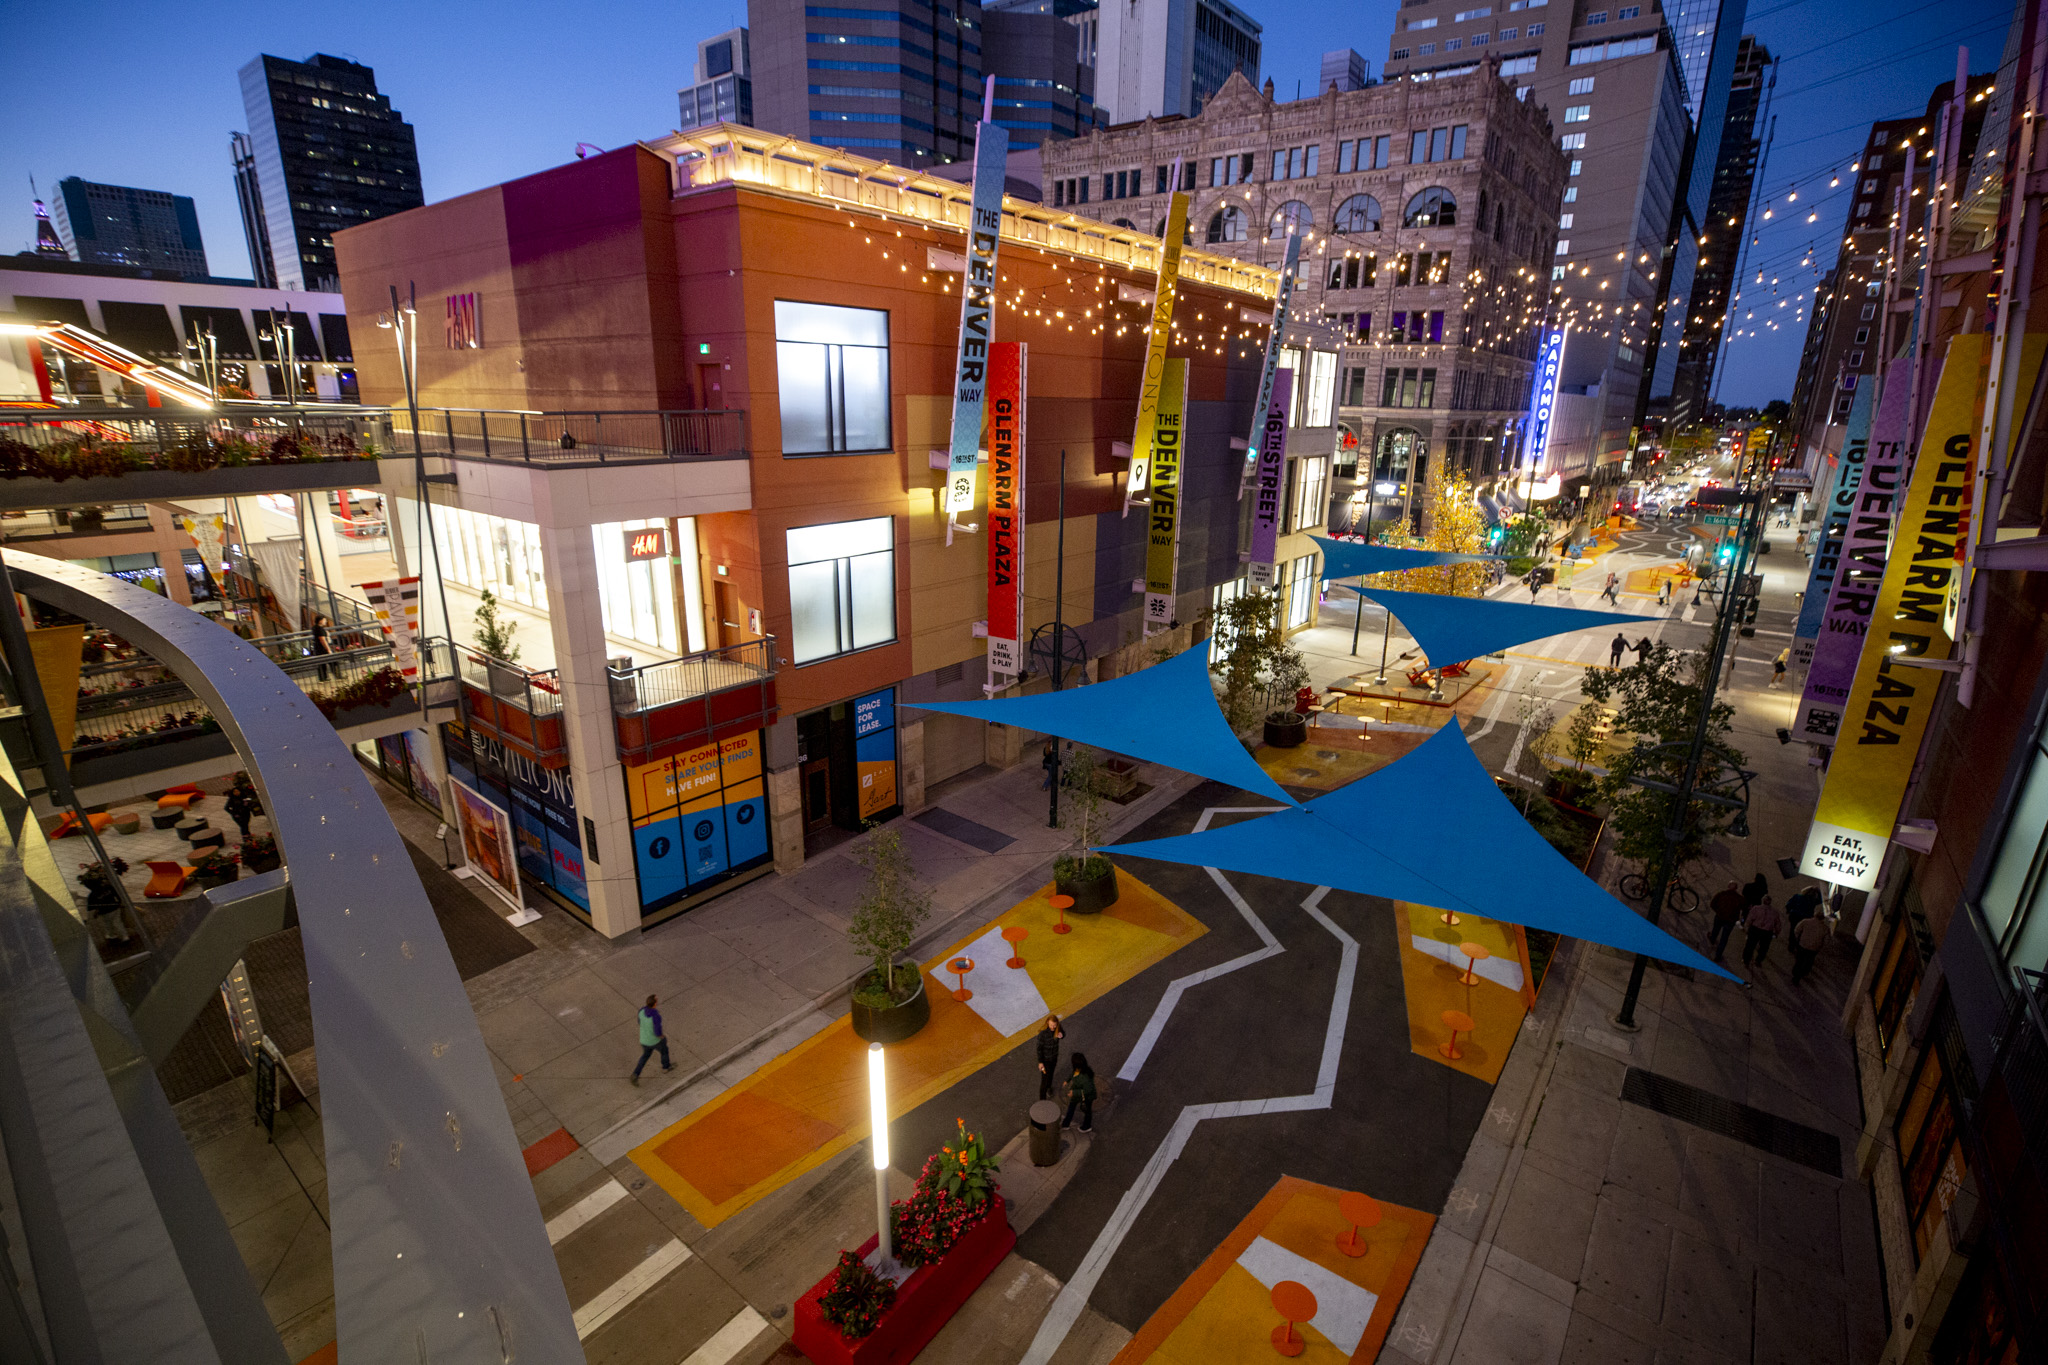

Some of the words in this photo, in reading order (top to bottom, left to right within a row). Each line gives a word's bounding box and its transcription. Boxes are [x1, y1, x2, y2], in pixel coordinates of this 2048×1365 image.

[976, 207, 998, 229] THE
[961, 231, 996, 383] DENVER
[443, 292, 479, 349] H&M
[960, 389, 982, 402] WAY
[1260, 360, 1276, 413] PLAZA
[1532, 334, 1562, 457] PARAMO
[1157, 413, 1179, 426] THE
[995, 399, 1012, 511] GLENARM
[1152, 429, 1178, 533] DENVER
[1713, 516, 1726, 525] 16th
[1727, 518, 1748, 527] Stret
[1896, 434, 1972, 623] GLENARM
[631, 533, 659, 556] H&M
[995, 516, 1011, 586] PLAZA
[1151, 534, 1172, 547] WAY
[993, 650, 1012, 660] DRINK,
[996, 643, 1008, 651] EAT,
[1794, 649, 1813, 657] DENV
[998, 660, 1012, 668] PLAY
[1799, 657, 1812, 665] WA
[1858, 631, 1932, 745] PLAZA
[857, 699, 881, 713] SPACE
[858, 712, 873, 723] FOR
[858, 720, 881, 734] LEASE.
[470, 729, 482, 756] DENVE
[663, 758, 687, 772] STAY
[689, 738, 748, 763] CONNECTED
[665, 767, 697, 784] SHARE
[699, 757, 725, 773] YOUR
[727, 748, 754, 764] FINDS
[666, 780, 692, 797] HAVE
[694, 772, 717, 787] FUN!
[1834, 835, 1862, 852] EAT,
[1814, 857, 1824, 868] &
[1828, 860, 1866, 877] PLAY
[1820, 845, 1869, 867] DRINK,
[233, 976, 262, 1057] DIRECTO
